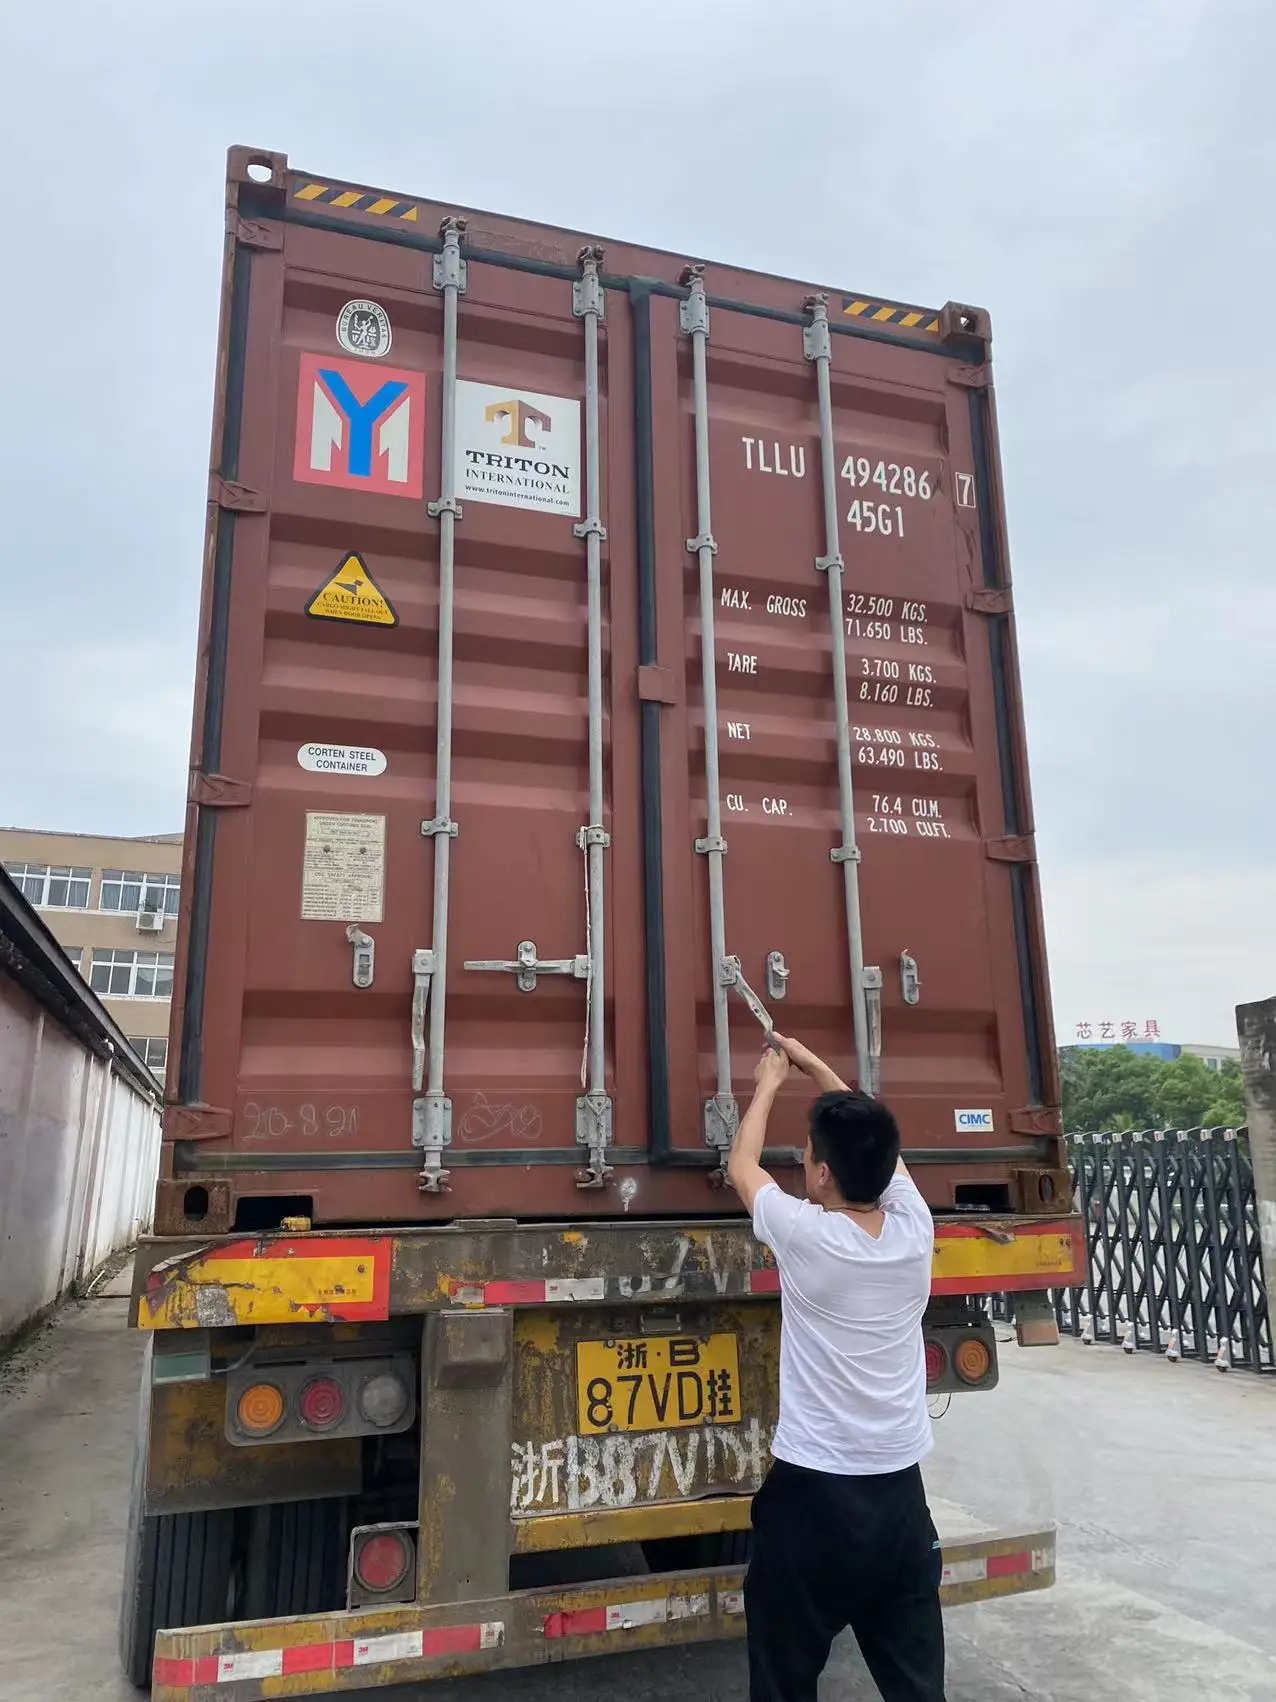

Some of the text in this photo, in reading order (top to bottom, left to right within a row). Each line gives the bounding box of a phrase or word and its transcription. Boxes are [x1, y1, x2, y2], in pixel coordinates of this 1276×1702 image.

[341, 304, 387, 338] BUREAU VERITAS
[466, 450, 570, 479] TRITON
[742, 437, 806, 478] TLLU
[841, 456, 931, 500] 494286
[466, 469, 570, 494] INTERNATIONAL
[465, 484, 570, 506] www.tritoninternational.com
[847, 500, 904, 537] 45G1
[323, 592, 383, 608] CAUTION!
[720, 588, 751, 610] MAX.
[766, 595, 806, 617] GROSS
[901, 601, 928, 622] KGS.
[900, 626, 928, 645] LBS.
[727, 652, 758, 674] TARE
[908, 663, 936, 683] KGS.
[906, 687, 933, 707] LBS.
[727, 722, 751, 739] NET
[909, 732, 940, 748] KGS.
[308, 746, 376, 761] CORTEN STEEL
[858, 747, 943, 771] 63,490 LBS.
[316, 760, 368, 772] CONTAINER
[727, 794, 748, 811] CU.
[762, 797, 793, 816] CAP.
[872, 795, 902, 815] 76.4
[1076, 1019, 1161, 1040] 芯艺家具
[958, 1114, 991, 1125] CIMC
[586, 1369, 733, 1428] 87VD挂
